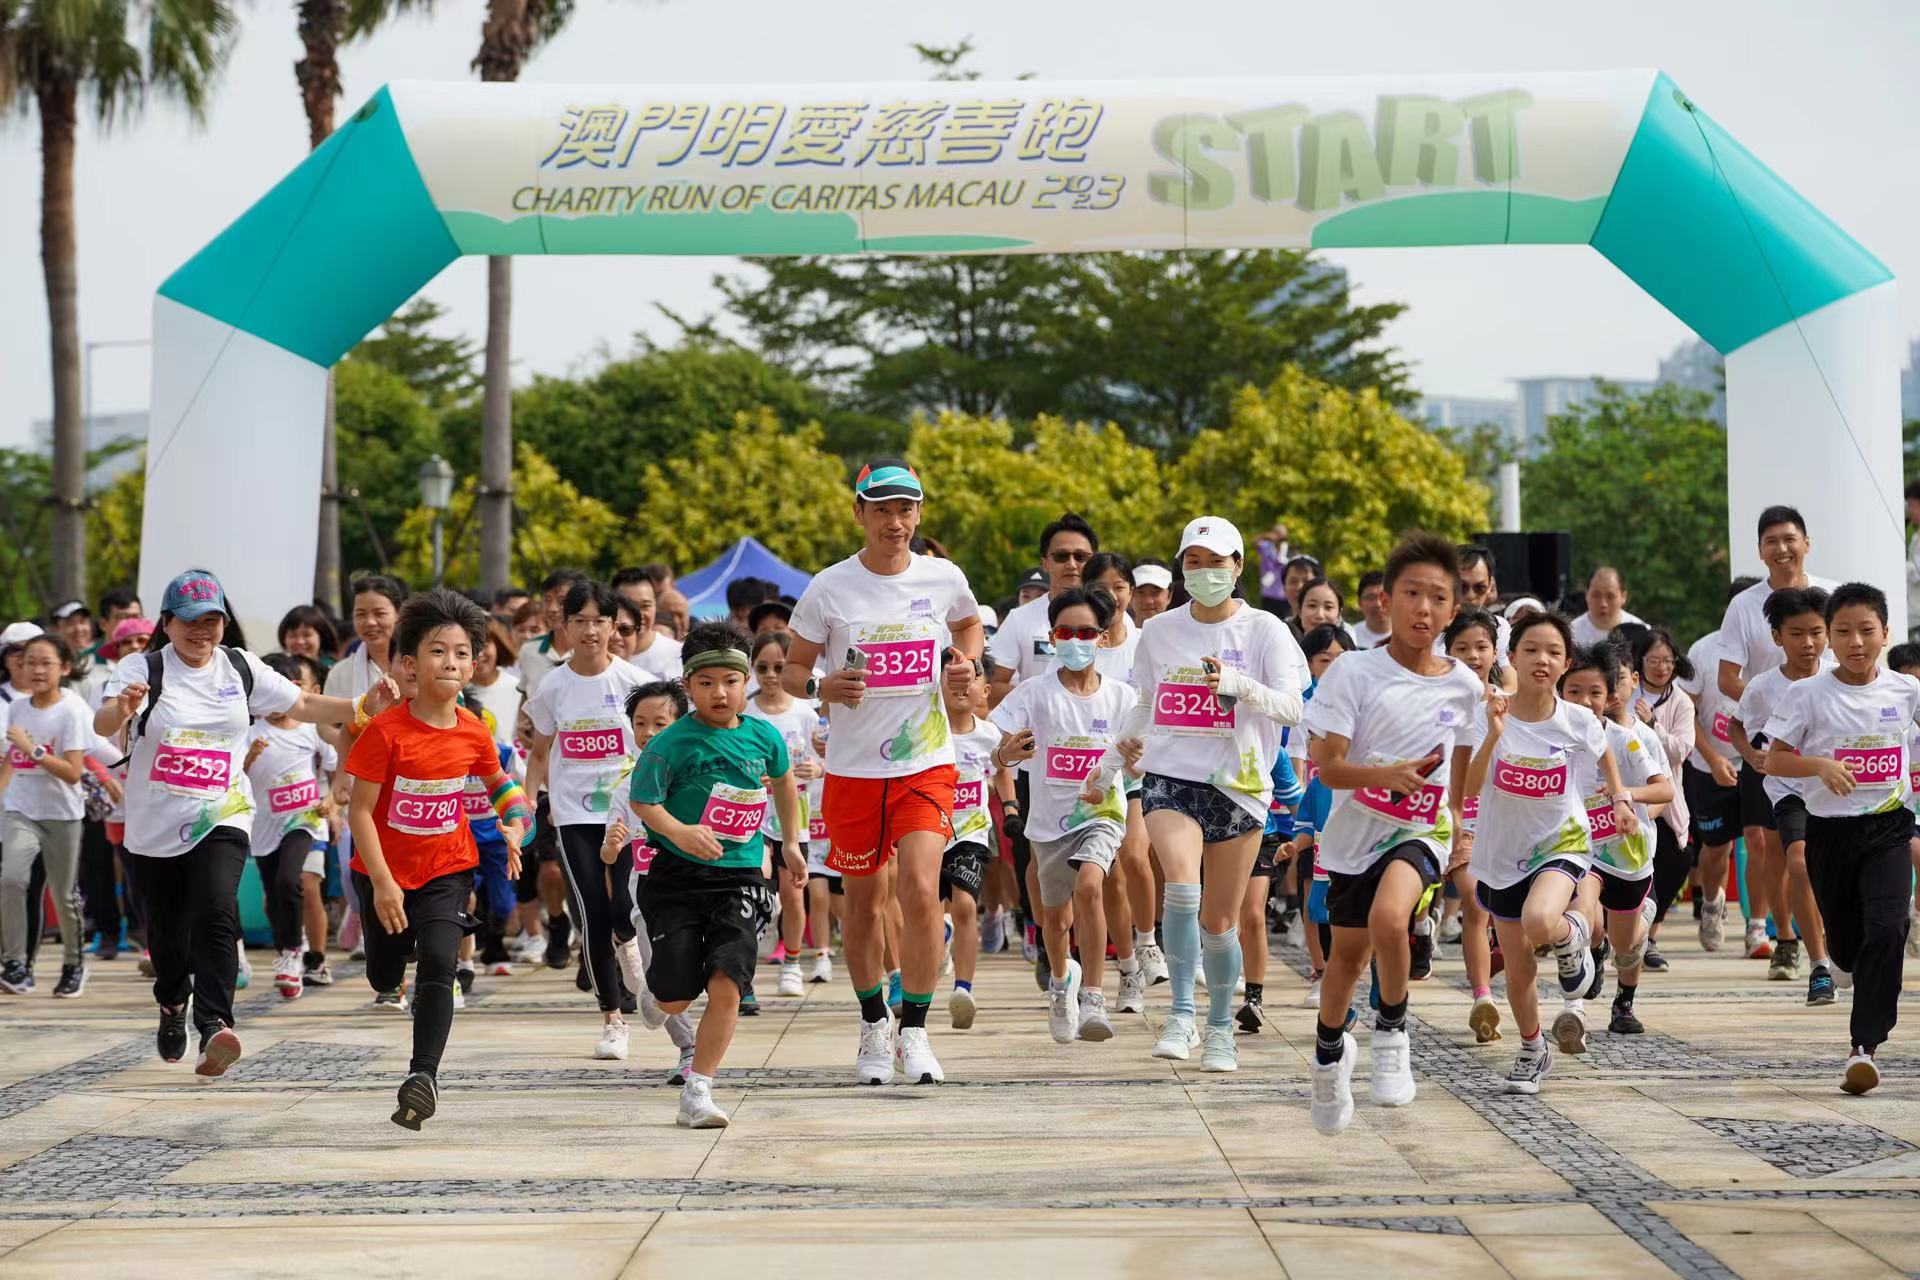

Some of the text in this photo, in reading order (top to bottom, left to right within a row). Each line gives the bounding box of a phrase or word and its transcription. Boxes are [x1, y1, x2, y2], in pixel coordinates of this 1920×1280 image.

[540, 99, 1103, 168] 澳門明愛慈善跑
[1147, 89, 1533, 213] START
[512, 185, 647, 212] CHARITY
[649, 184, 716, 211] RUN
[721, 184, 766, 211] OF
[771, 182, 901, 211] CARITAS
[903, 179, 1027, 210] MACAU
[867, 648, 931, 676] 3325
[564, 734, 619, 752] C3808
[154, 753, 227, 781] C3252
[1052, 753, 1098, 772] C374
[1499, 769, 1562, 791] C3800
[272, 783, 315, 807] C3877
[463, 795, 489, 810] 379
[1363, 787, 1436, 813] C399
[395, 798, 457, 820] C3780
[708, 806, 761, 828] C3789
[1588, 810, 1616, 832] 380
